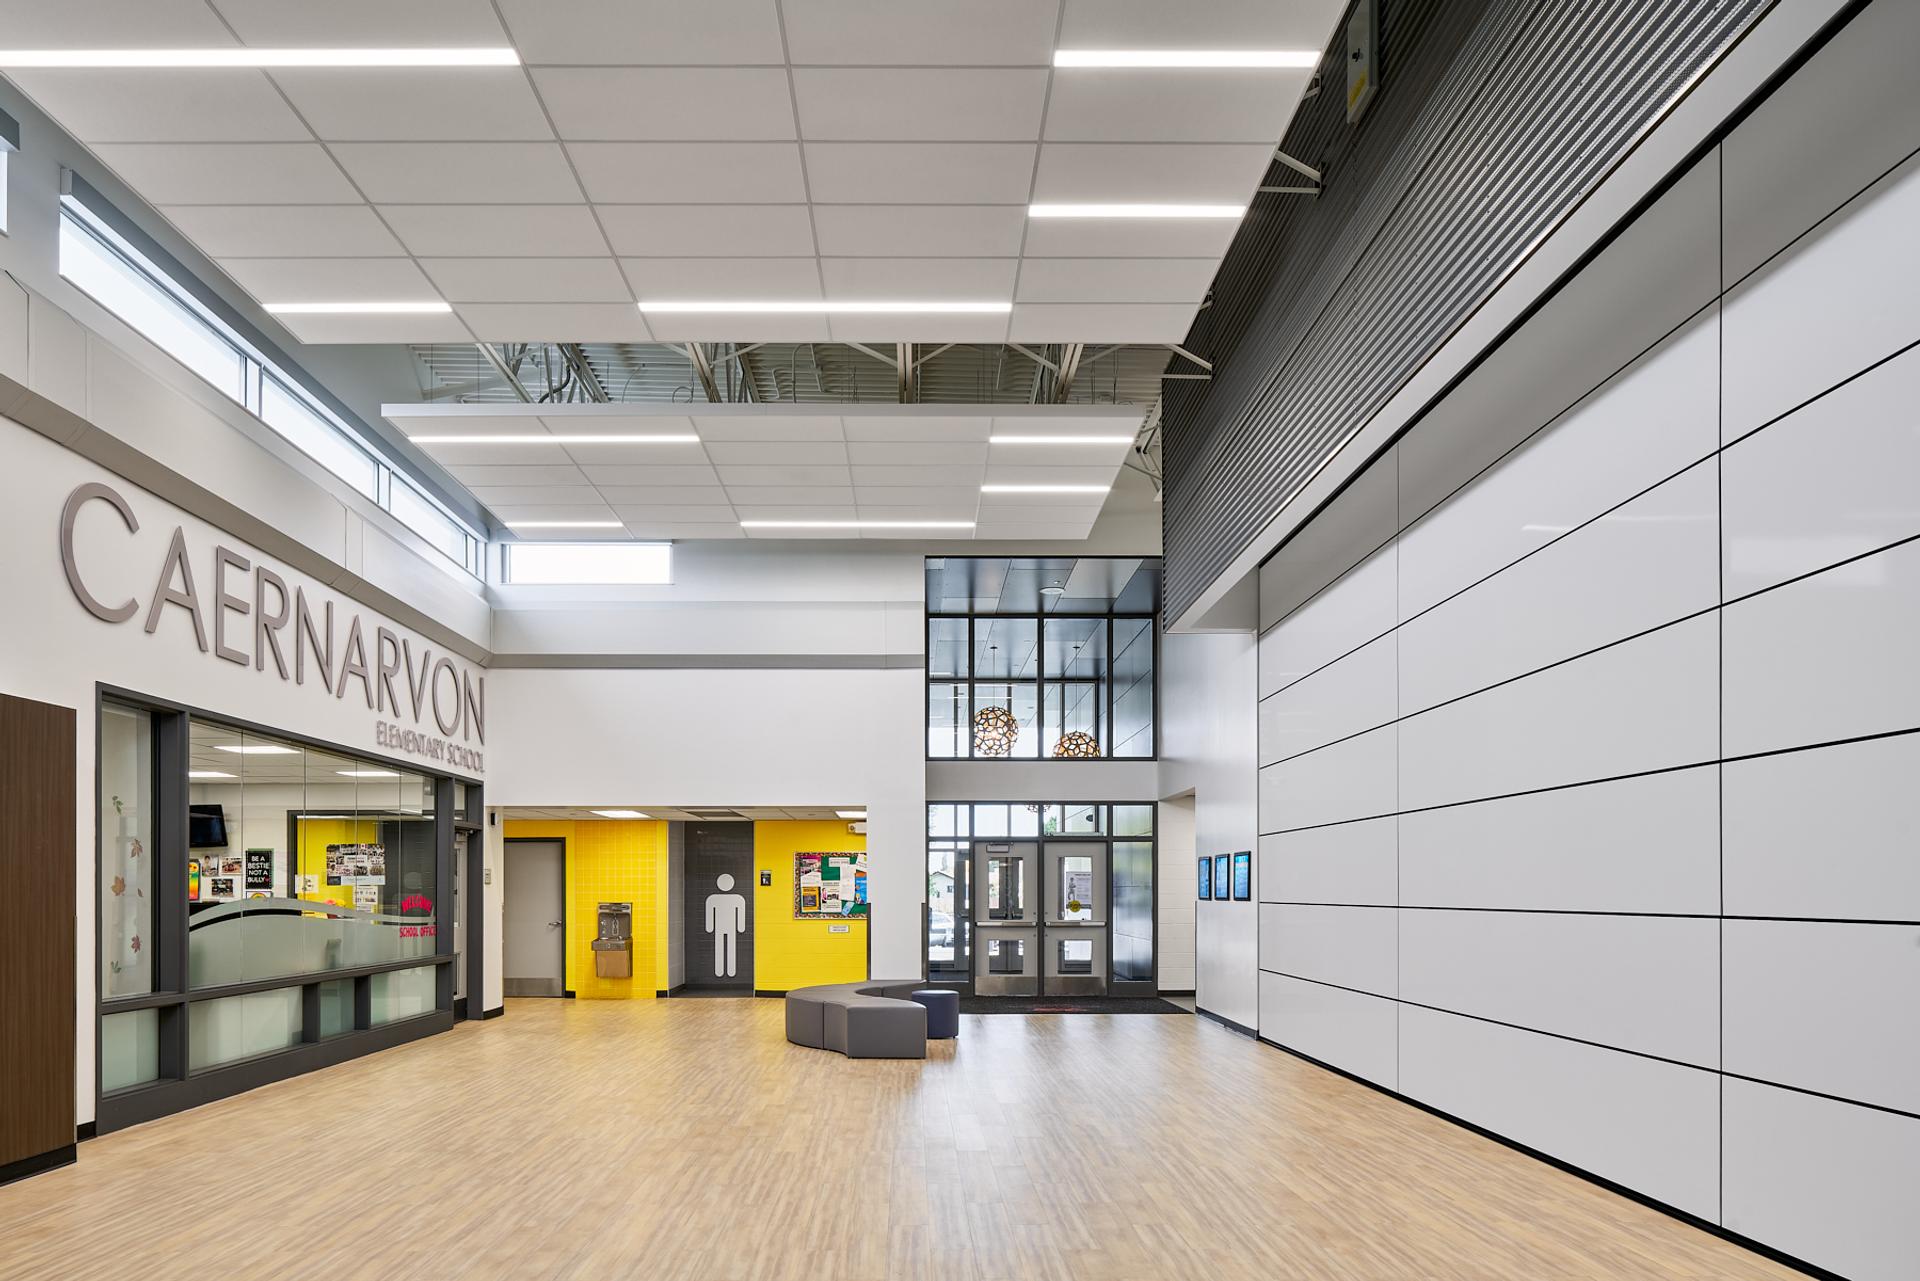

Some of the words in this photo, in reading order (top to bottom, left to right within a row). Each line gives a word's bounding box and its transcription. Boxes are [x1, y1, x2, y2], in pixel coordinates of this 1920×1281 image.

[60, 482, 485, 746] CAERNARVON
[376, 719, 445, 761] ELEMENTARY
[447, 742, 485, 773] SCHOOL
[247, 862, 270, 870] BESTIE
[401, 895, 433, 913] WELCOME
[399, 926, 419, 938] SCHOOL
